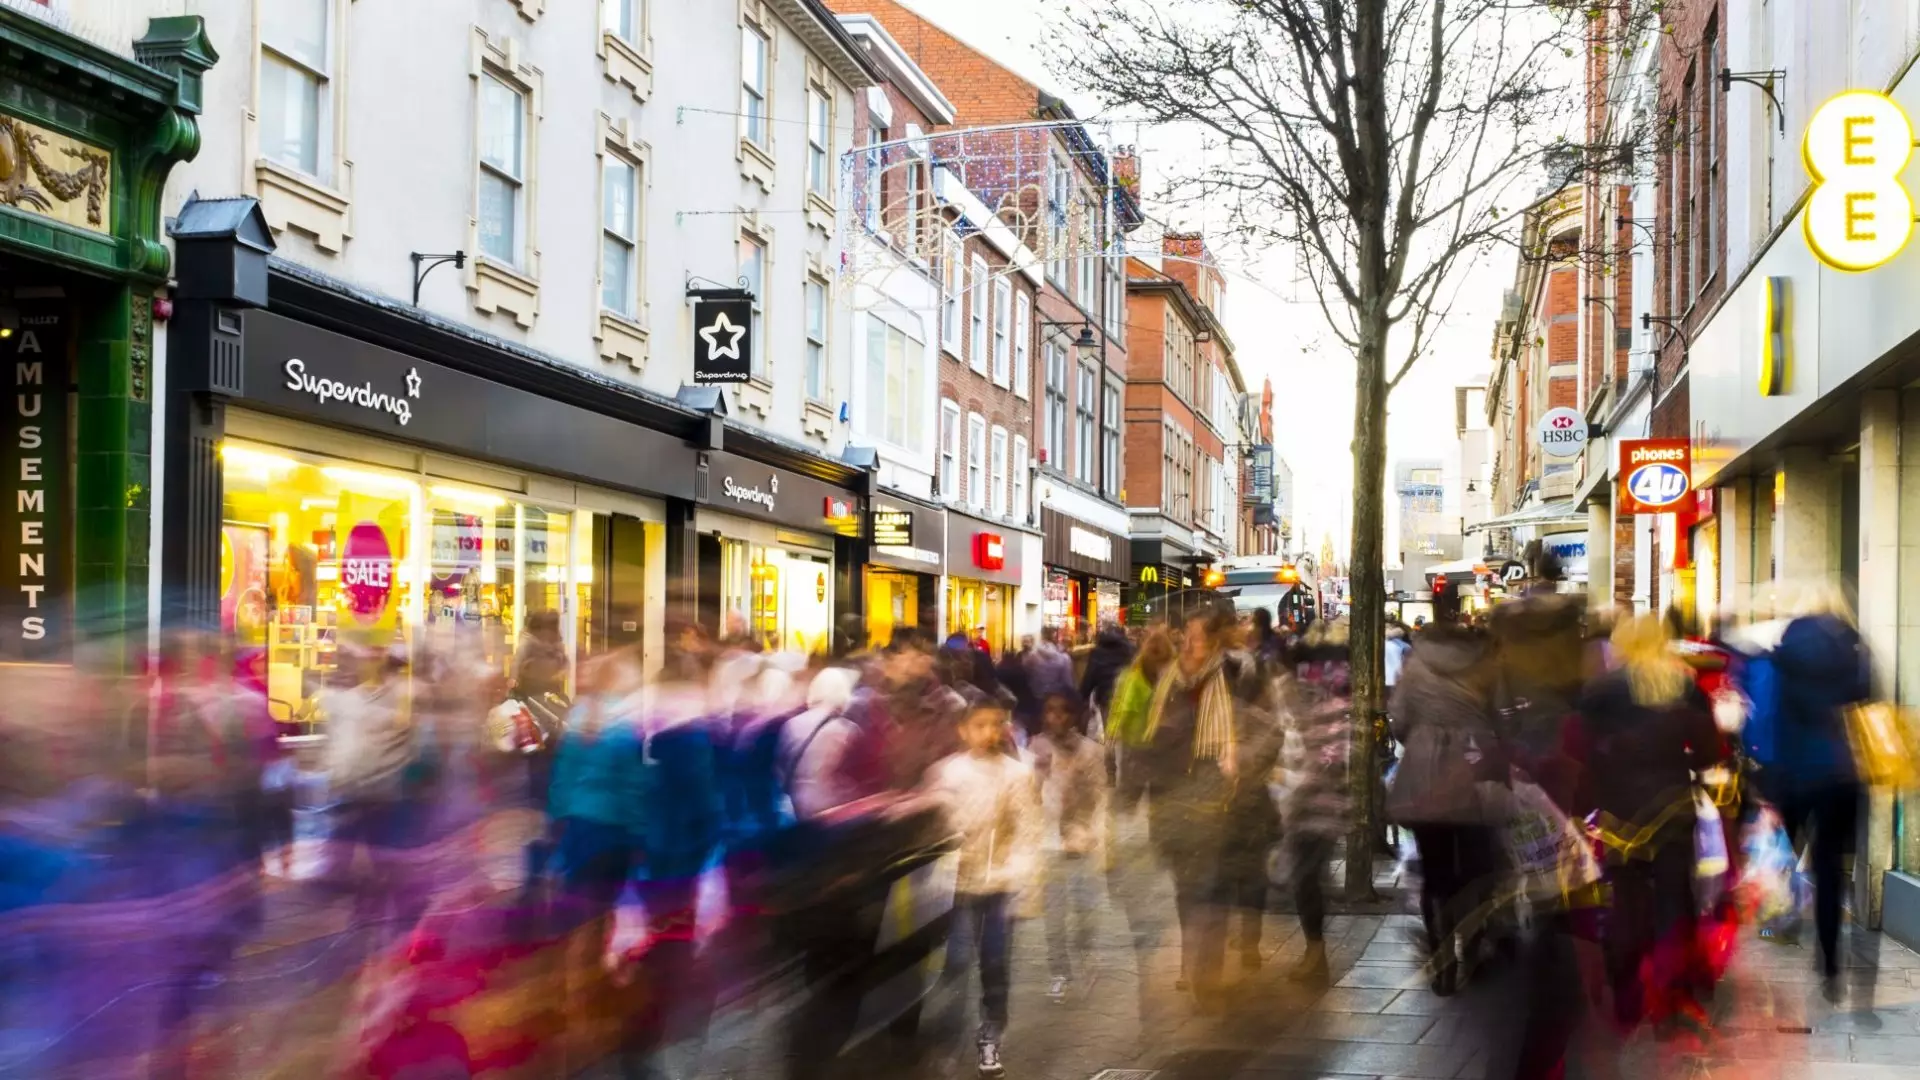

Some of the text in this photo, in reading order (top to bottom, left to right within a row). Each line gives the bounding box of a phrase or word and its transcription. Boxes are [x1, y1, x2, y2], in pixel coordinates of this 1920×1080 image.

[695, 370, 748, 379] Superdrug
[286, 358, 412, 425] Superdrug
[1543, 429, 1584, 443] HSBC
[1631, 447, 1684, 463] phones
[17, 330, 46, 640] AMUSEMENTS
[724, 476, 774, 512] Superdrug
[346, 560, 388, 588] SALE
[1502, 566, 1524, 583] JD
